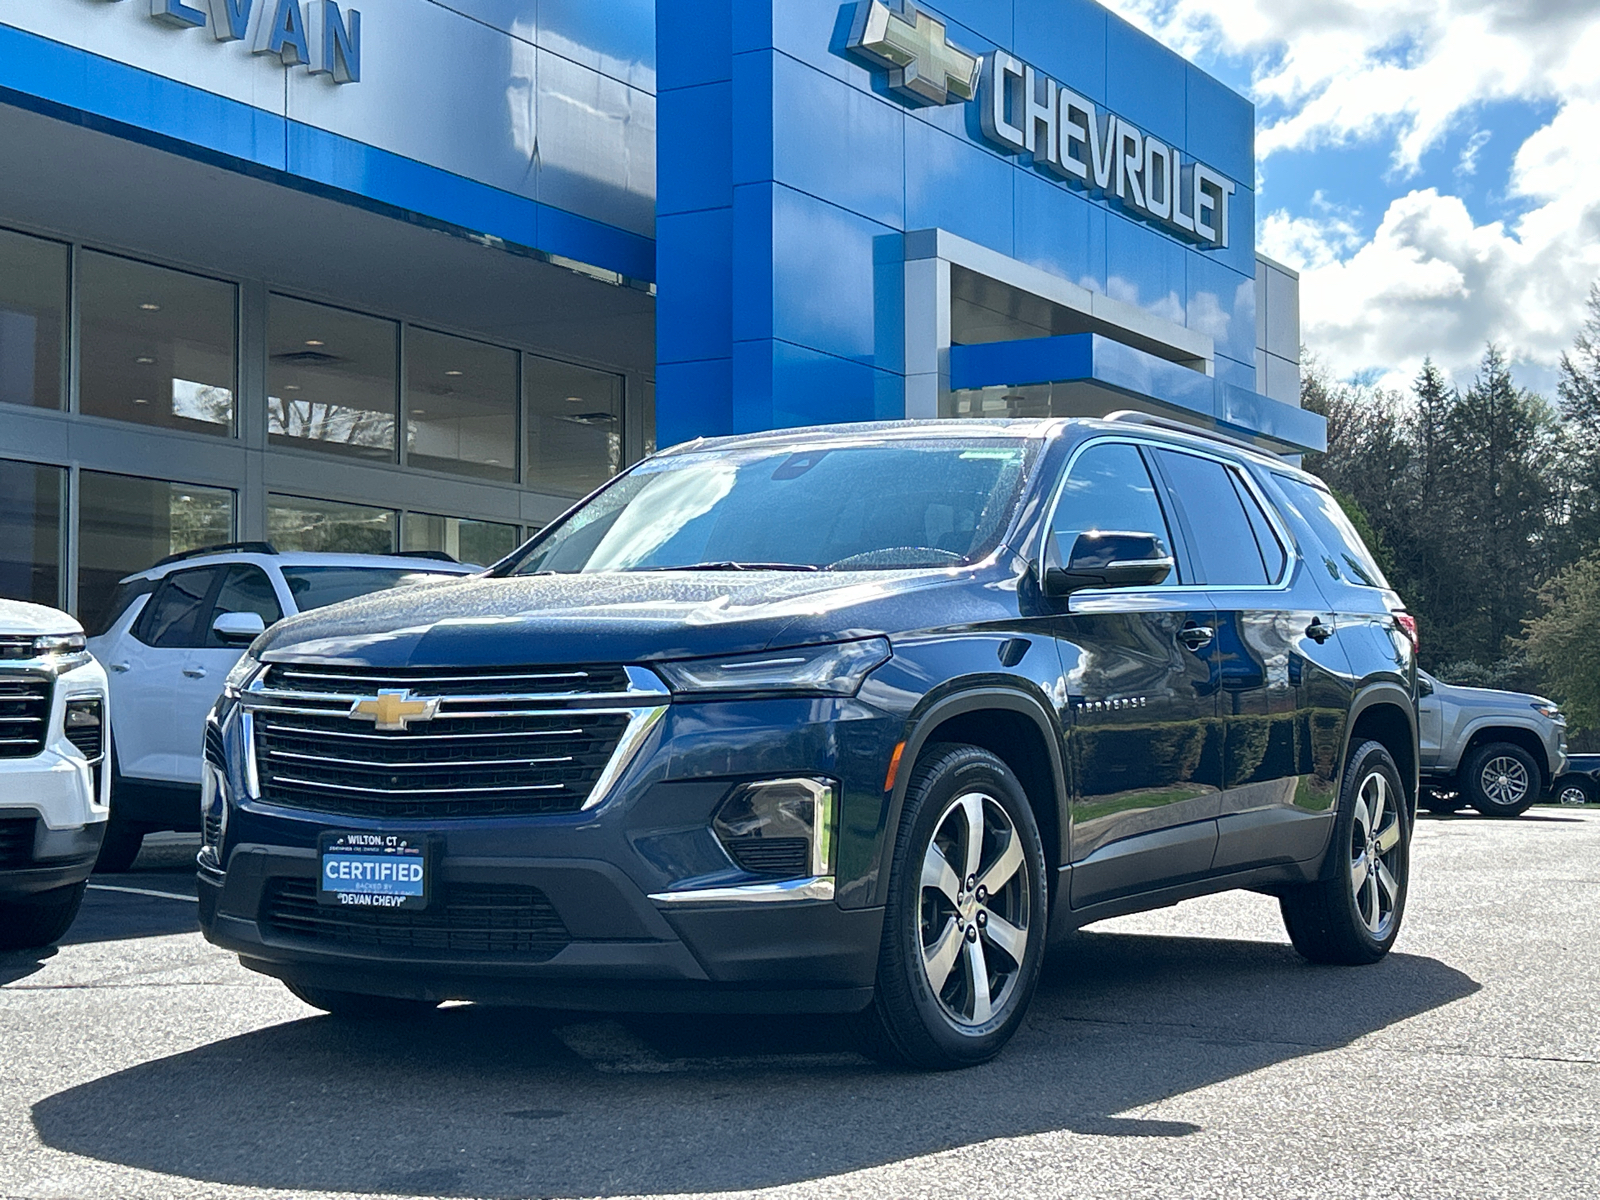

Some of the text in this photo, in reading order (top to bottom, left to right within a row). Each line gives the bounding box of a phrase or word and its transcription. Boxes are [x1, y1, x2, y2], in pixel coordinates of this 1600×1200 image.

[992, 49, 1236, 249] CHEVROLET
[1077, 696, 1146, 714] TRAVERSE
[347, 834, 398, 846] WILTON, CT
[326, 861, 423, 881] CERTIFIED
[341, 893, 401, 907] DEVAN CHEVY
